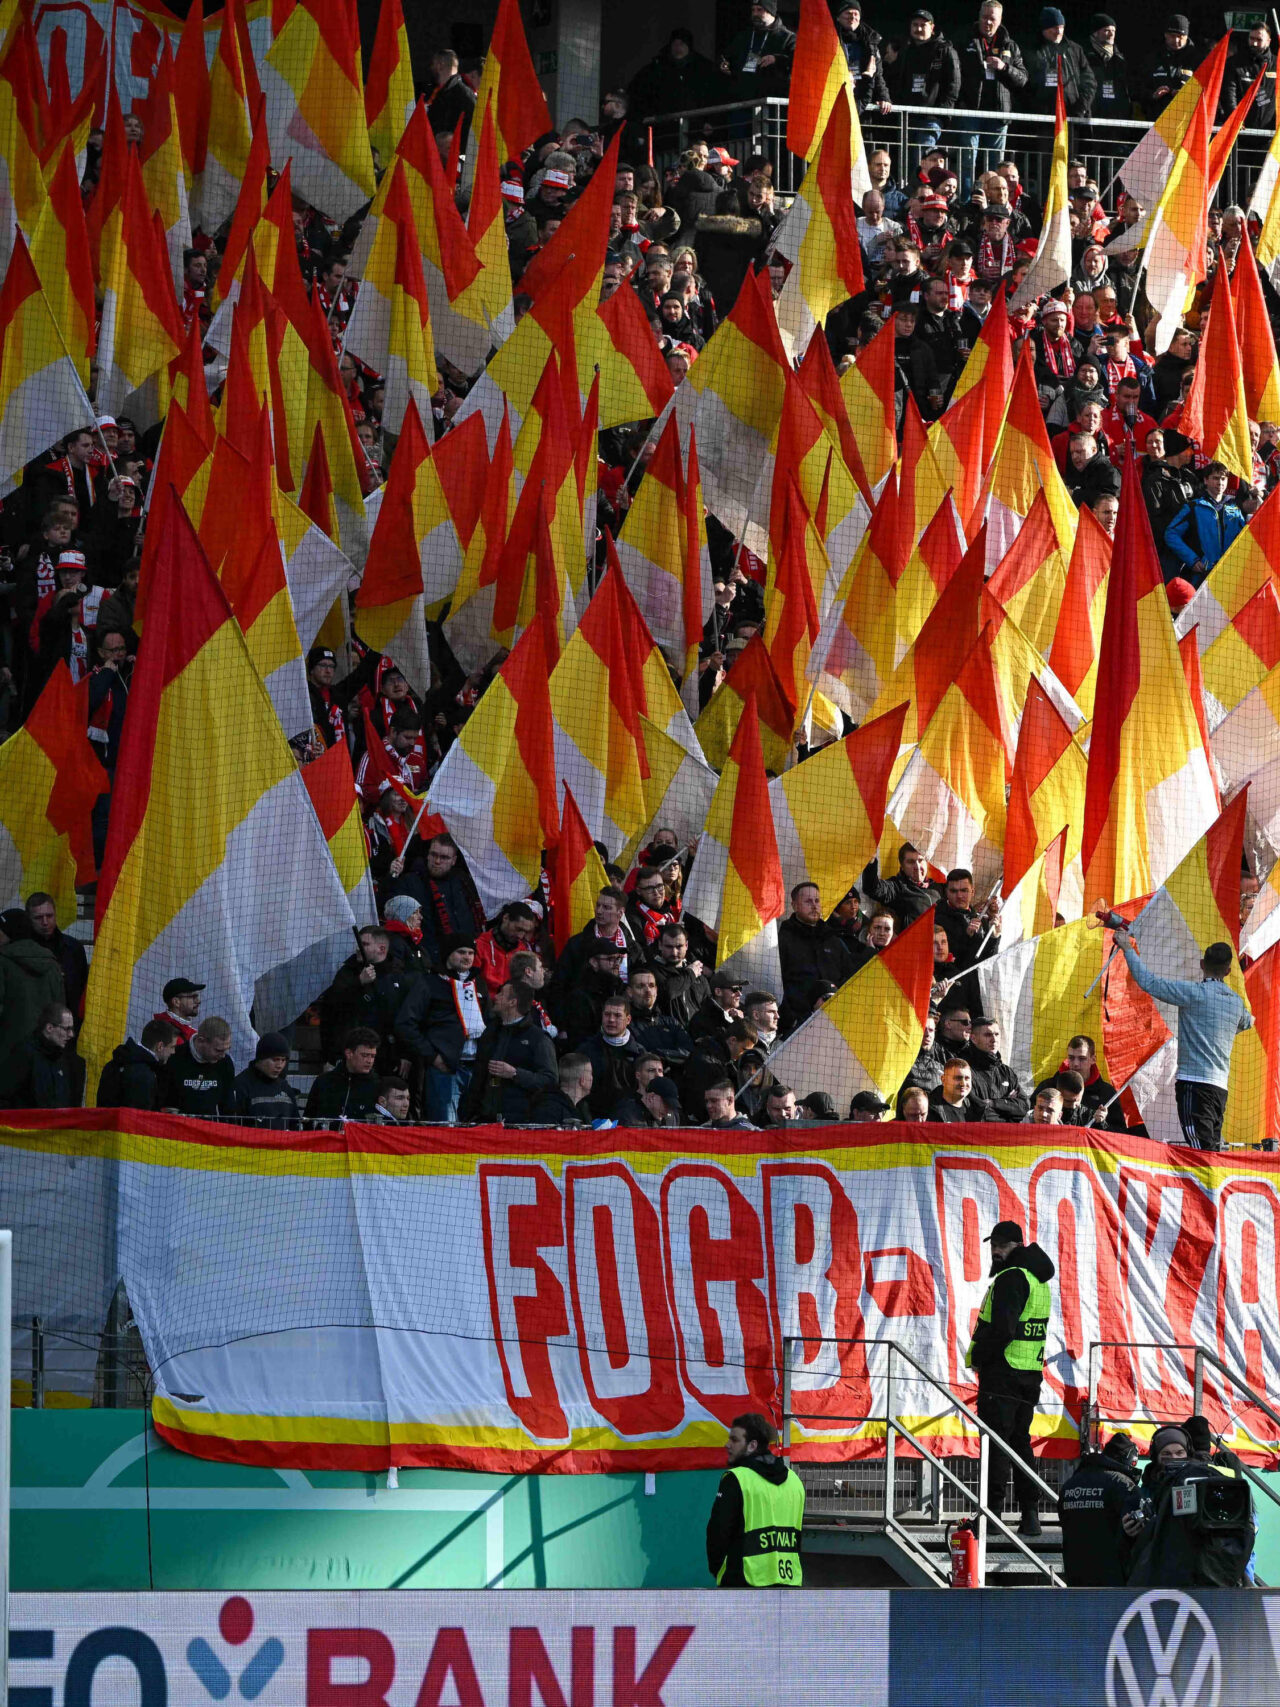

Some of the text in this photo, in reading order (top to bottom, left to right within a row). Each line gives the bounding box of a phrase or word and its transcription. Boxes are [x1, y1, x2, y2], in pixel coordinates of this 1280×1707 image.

[1064, 1487, 1104, 1499] PROTECT
[778, 1559, 794, 1580] 66
[306, 1625, 697, 1707] BANK
